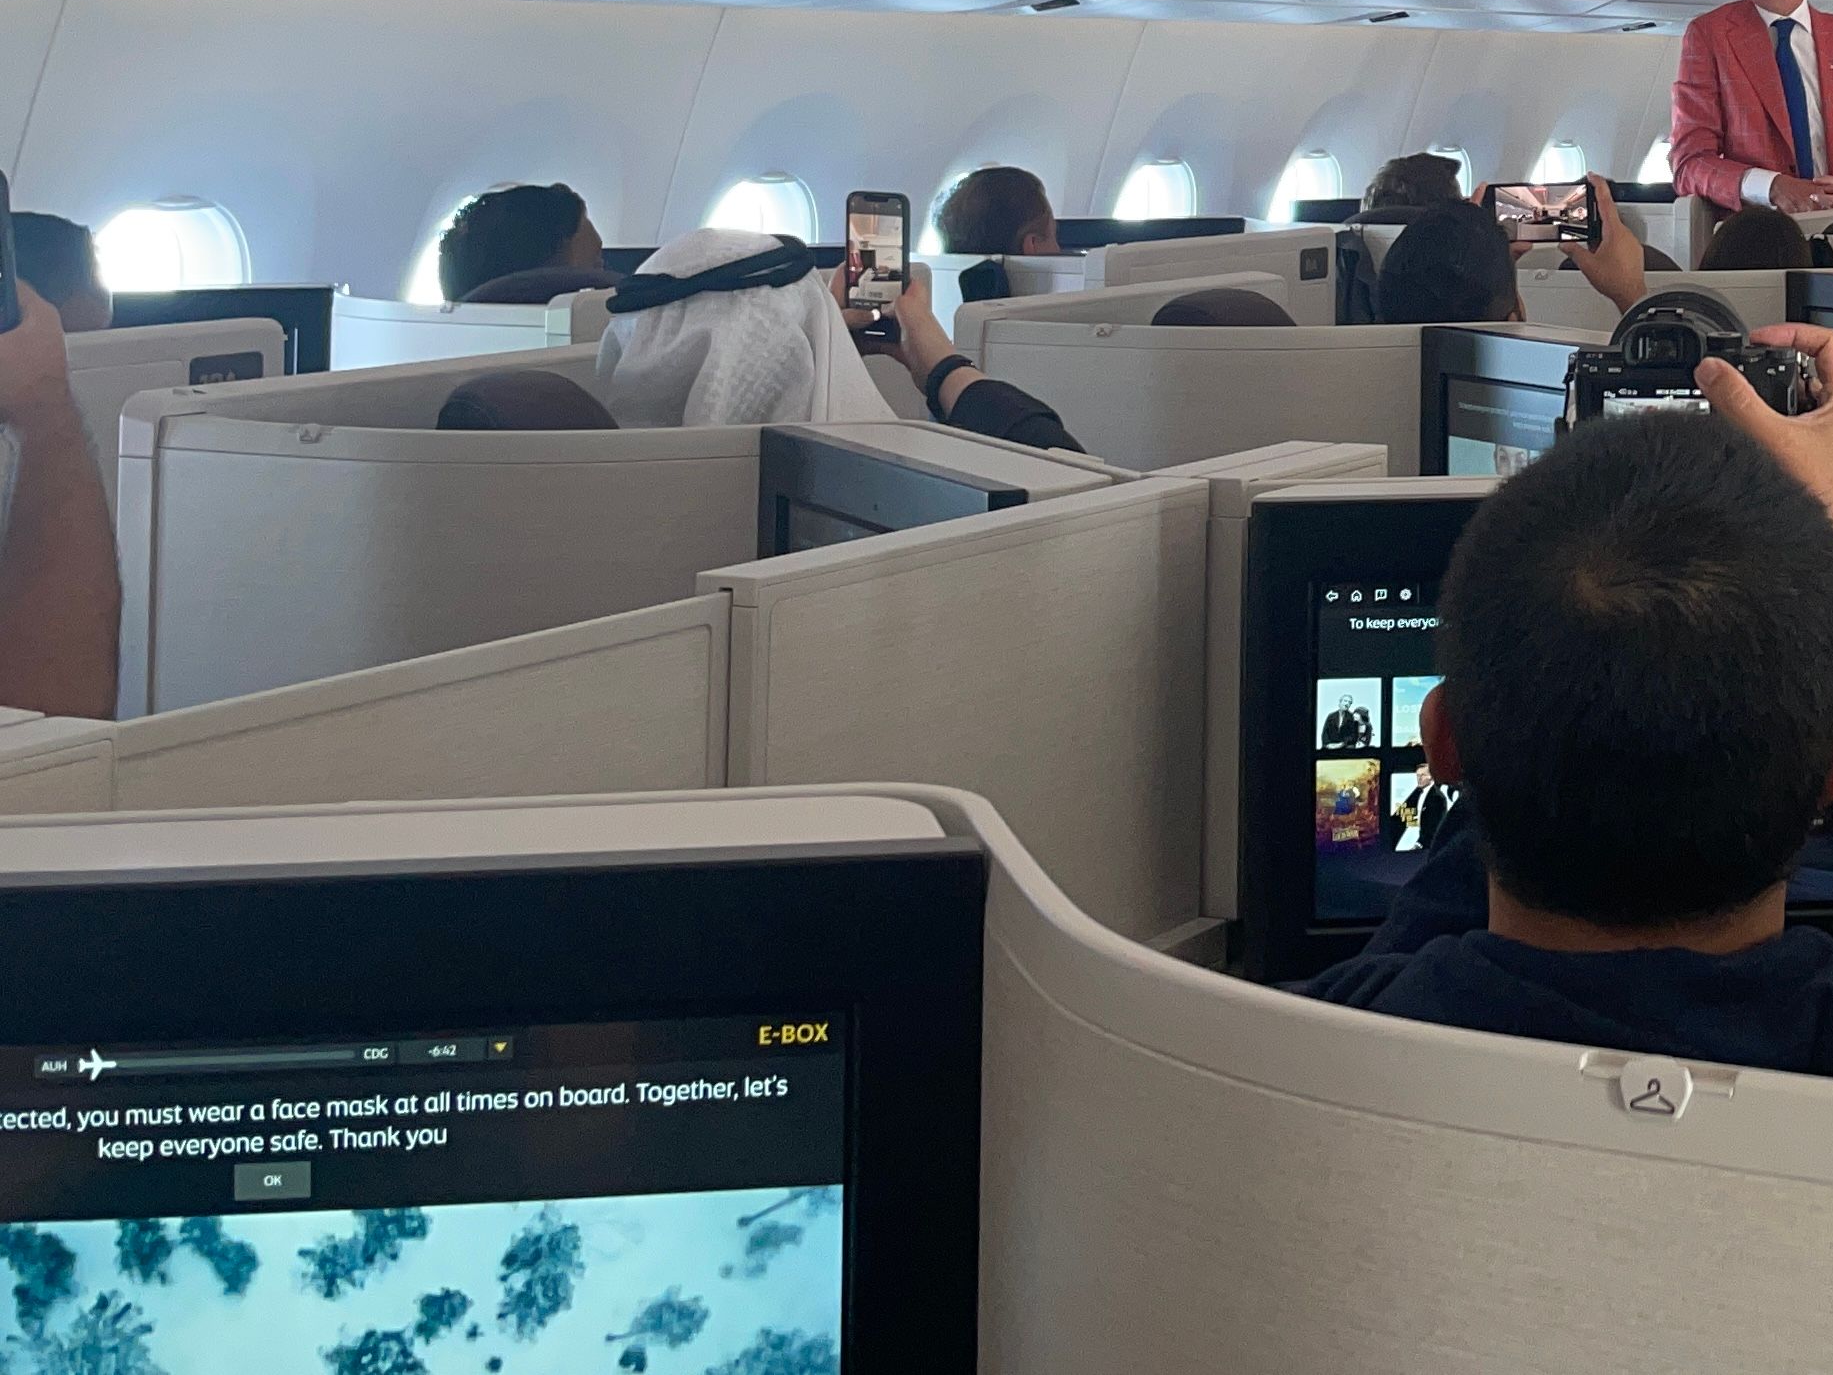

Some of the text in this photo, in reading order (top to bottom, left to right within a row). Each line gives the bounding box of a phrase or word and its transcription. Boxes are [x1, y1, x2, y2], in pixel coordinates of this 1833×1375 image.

[1349, 617, 1439, 631] To keep everyo
[758, 1021, 829, 1046] E-BOX
[41, 1060, 68, 1073] AUH
[363, 1047, 389, 1061] CDG
[77, 1108, 119, 1132] you
[125, 1103, 182, 1126] must
[189, 1103, 244, 1123] wear
[250, 1103, 265, 1121] a
[271, 1098, 320, 1120] face
[326, 1095, 388, 1117] mask
[394, 1099, 418, 1114] at
[424, 1091, 451, 1114] all
[457, 1091, 518, 1112] times
[524, 1091, 554, 1109] on
[560, 1083, 630, 1106] board.
[636, 1079, 739, 1107] Together,
[744, 1075, 788, 1097] let's
[98, 1127, 447, 1161] keep everyone safe. Thank you
[264, 1174, 282, 1186] OK
